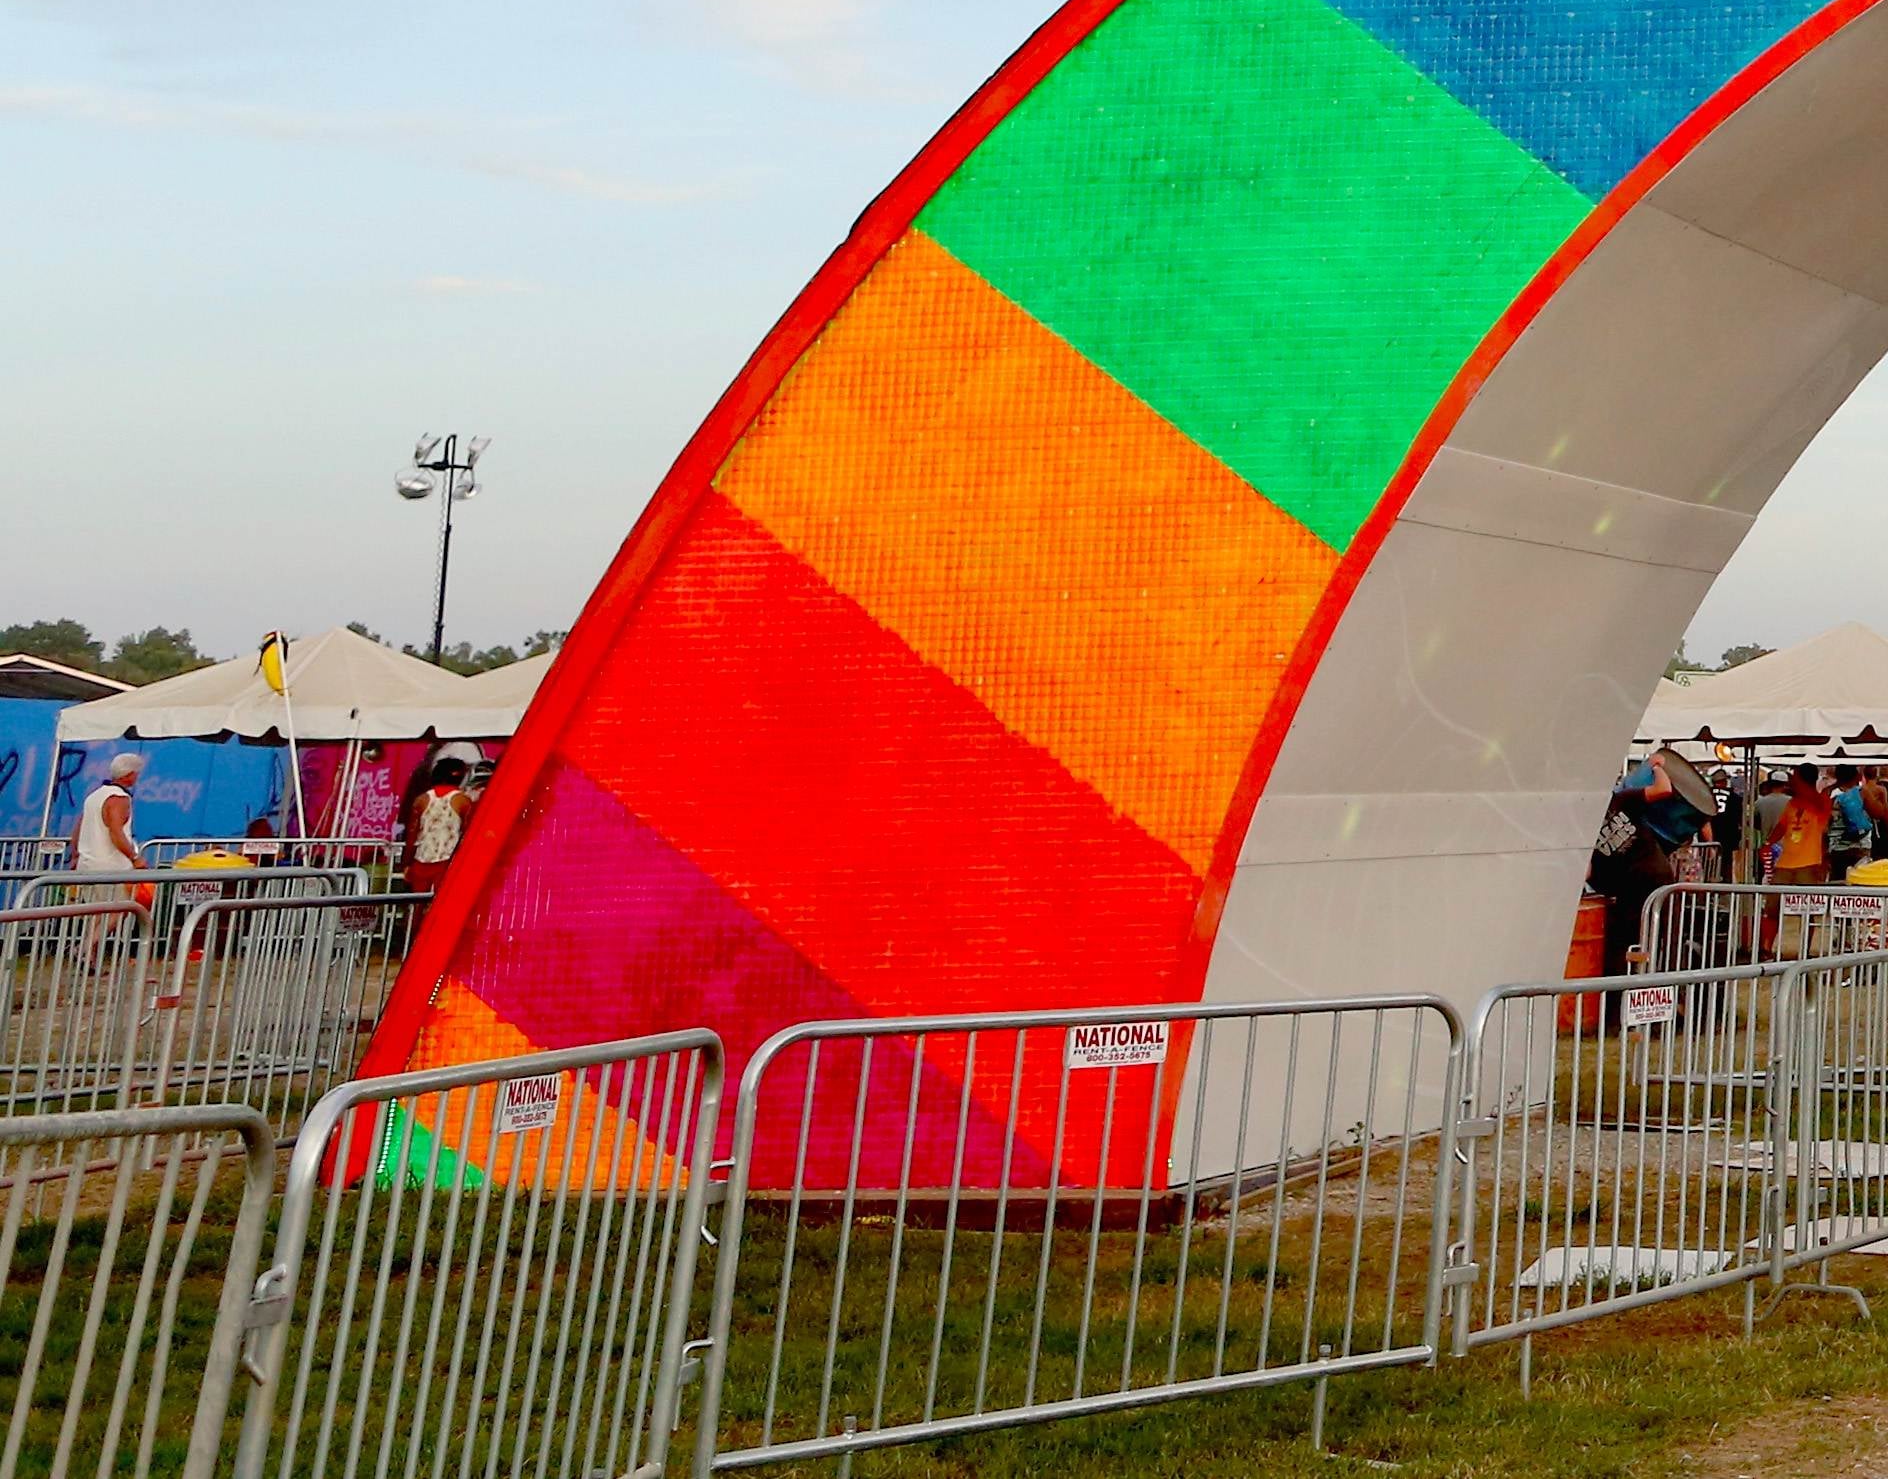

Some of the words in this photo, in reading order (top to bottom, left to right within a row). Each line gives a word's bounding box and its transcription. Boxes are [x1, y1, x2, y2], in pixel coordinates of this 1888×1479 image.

[179, 882, 221, 897] NATIONAL
[1833, 898, 1881, 909] NATIONAL
[339, 905, 377, 921] NATIONAL
[1629, 988, 1672, 1009] NATIONAL
[1075, 1023, 1165, 1049] NATIONAL
[1073, 1044, 1164, 1056] RENT-A-FENCE
[507, 1076, 558, 1108] NATIONAL
